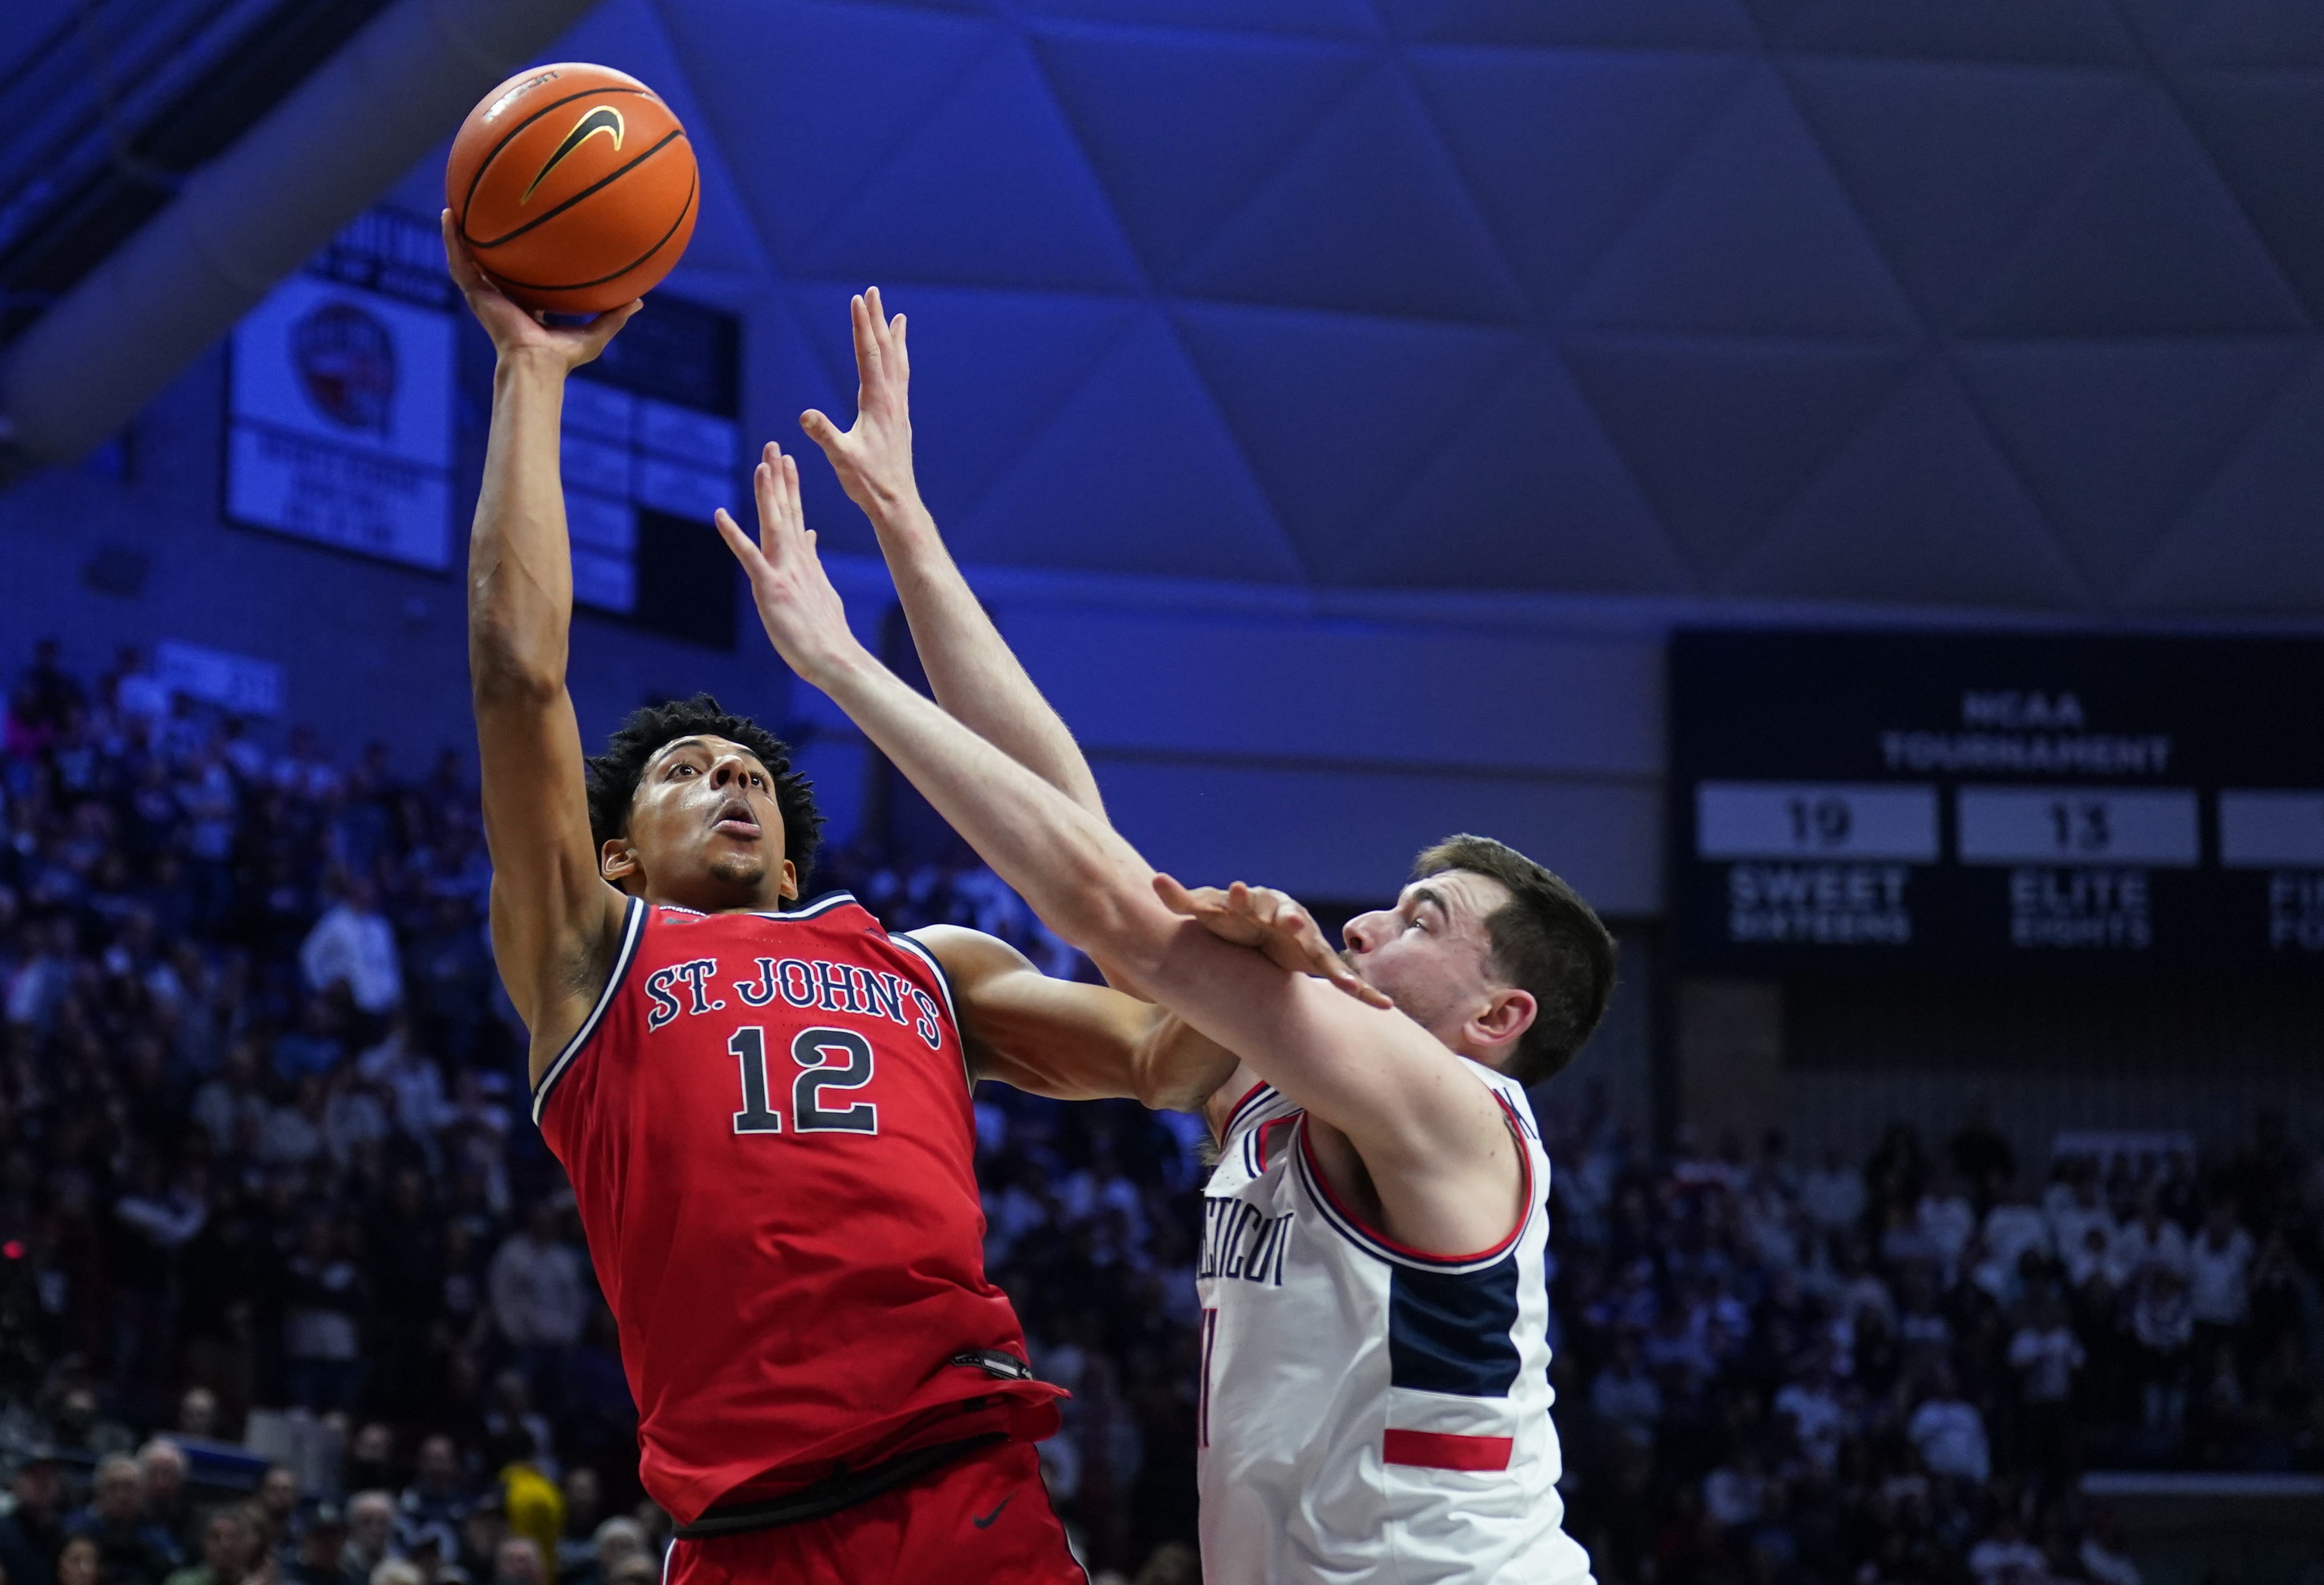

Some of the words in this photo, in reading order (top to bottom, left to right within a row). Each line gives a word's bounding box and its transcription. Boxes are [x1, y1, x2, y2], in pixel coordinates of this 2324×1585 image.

[1963, 691, 2084, 727] NCAA
[1881, 731, 2171, 773] TOURNAMENT
[1729, 865, 1910, 910] SWEET
[2011, 868, 2149, 913] ELITE
[2011, 914, 2151, 950] EIGHTS
[645, 958, 726, 1034] ST.
[733, 958, 942, 1051] JOHN'S
[727, 1026, 878, 1135] 12
